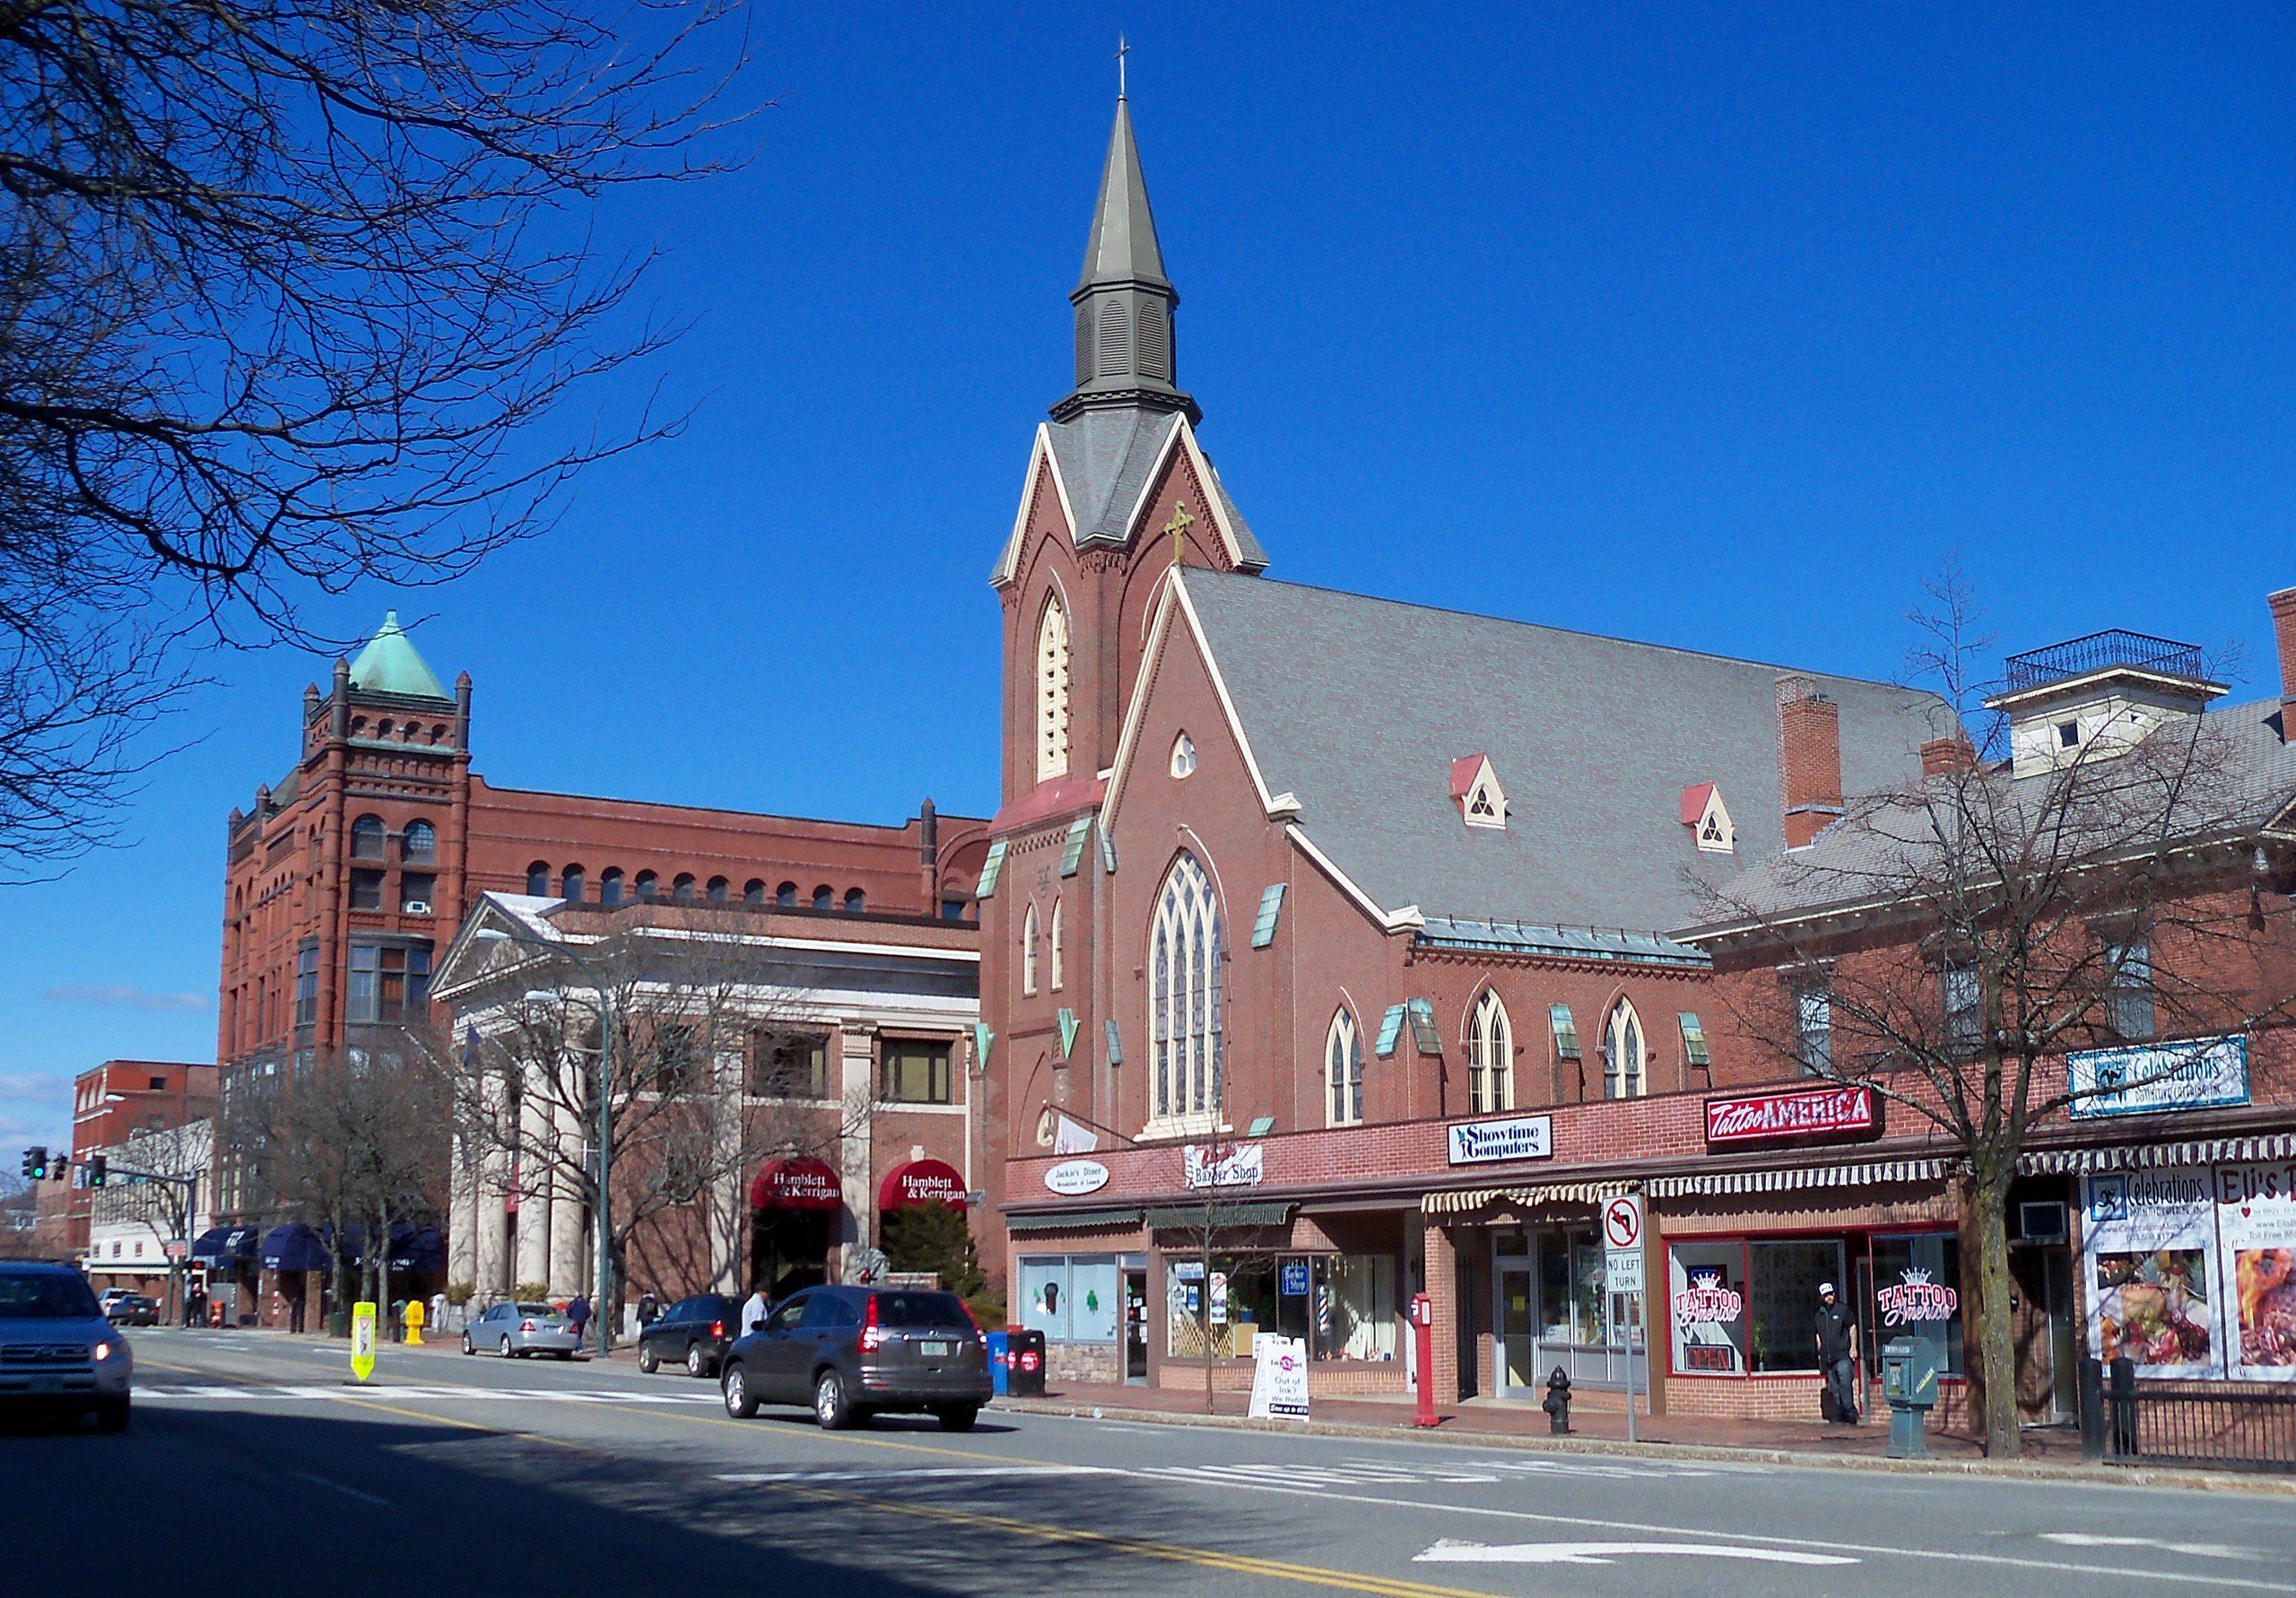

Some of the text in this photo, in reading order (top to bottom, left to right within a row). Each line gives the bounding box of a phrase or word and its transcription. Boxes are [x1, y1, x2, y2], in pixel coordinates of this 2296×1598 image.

[1466, 1125, 1539, 1144] Showtime
[1466, 1139, 1540, 1159] Computers
[774, 1172, 826, 1186] Hamblett
[1083, 1167, 1101, 1176] Diner
[1196, 1164, 1258, 1186] Barber Shop
[791, 1185, 839, 1200] Kerrigan
[902, 1176, 952, 1191] Hamblett
[2126, 1174, 2205, 1207] Celebrations
[2221, 1168, 2278, 1204] Eli's
[908, 1186, 966, 1202] & Kerrigan
[1608, 1259, 1639, 1271] NO LEFT
[1615, 1276, 1636, 1287] TURN
[1674, 1289, 1742, 1314] TATTOO
[1878, 1283, 1957, 1312] TATTOO
[1688, 1348, 1732, 1370] OPEN
